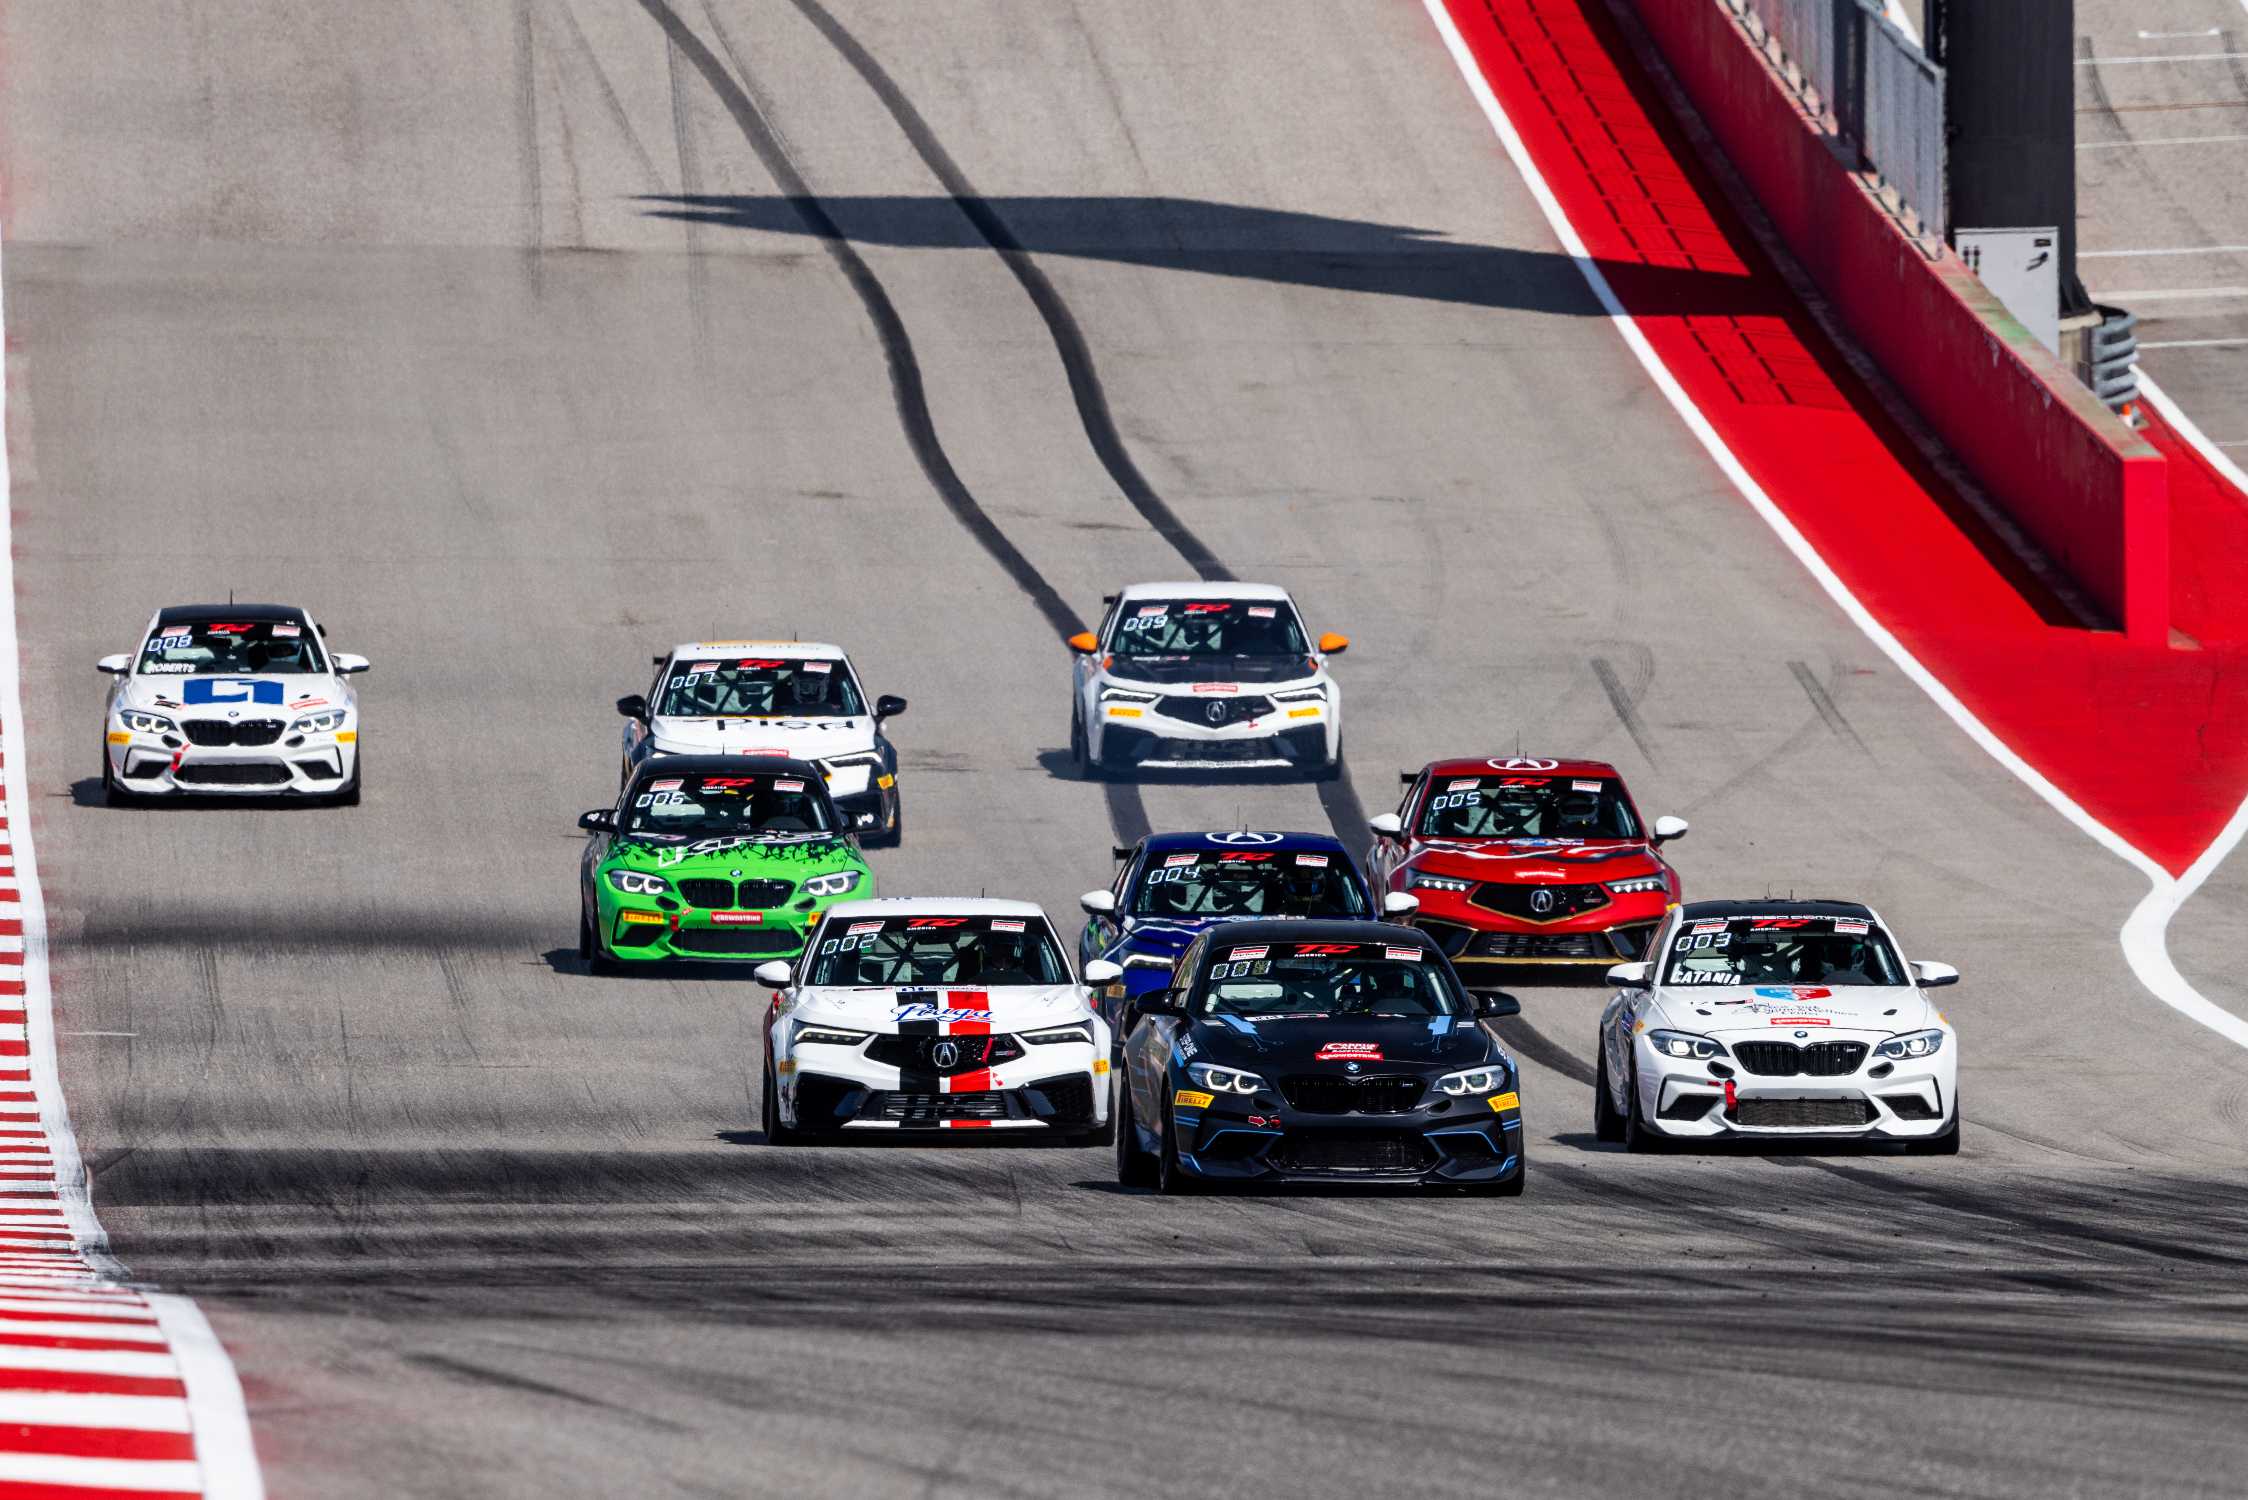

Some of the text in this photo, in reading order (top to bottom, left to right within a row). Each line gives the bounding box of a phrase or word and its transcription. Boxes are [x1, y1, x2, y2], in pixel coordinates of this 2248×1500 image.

[1123, 614, 1168, 632] 009
[148, 635, 192, 652] 008
[670, 671, 716, 690] 007
[636, 791, 684, 808] 006
[1433, 791, 1480, 810] 005
[1148, 866, 1200, 885] 004
[821, 933, 878, 955] 002
[1676, 932, 1732, 952] 003
[1669, 968, 1742, 986] CATANIA
